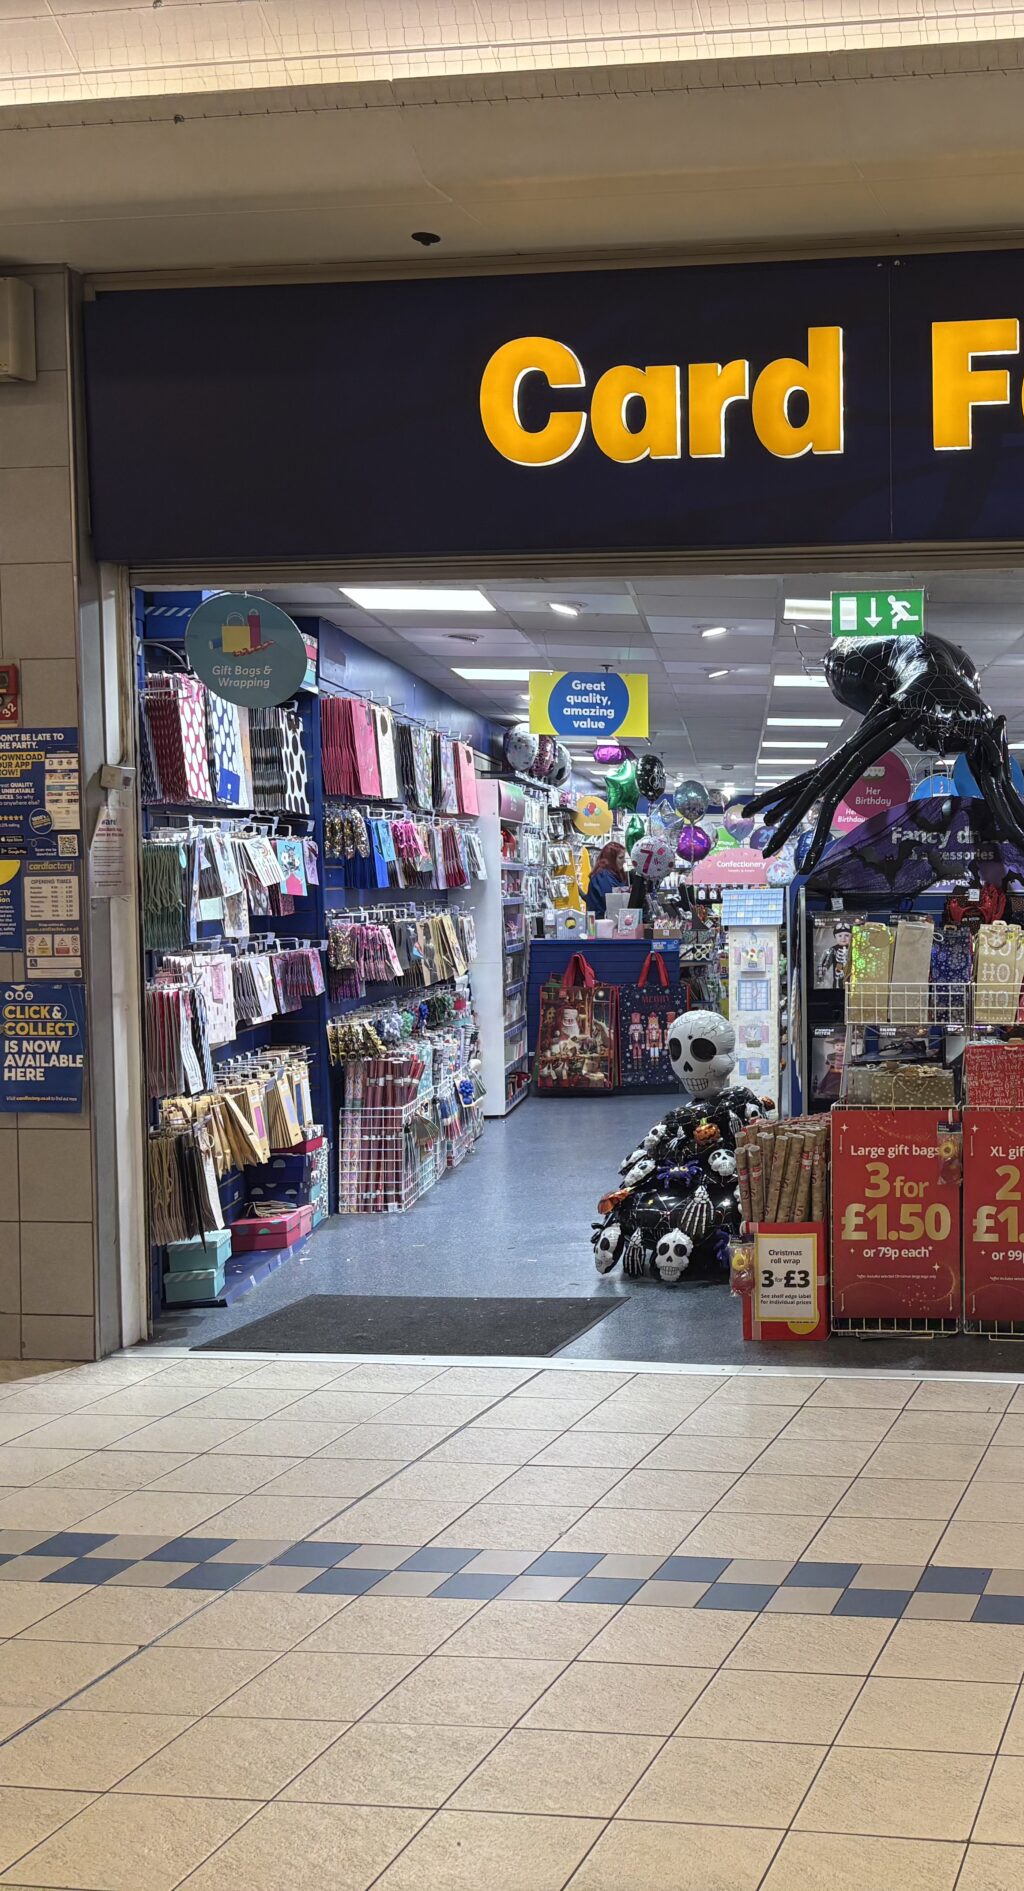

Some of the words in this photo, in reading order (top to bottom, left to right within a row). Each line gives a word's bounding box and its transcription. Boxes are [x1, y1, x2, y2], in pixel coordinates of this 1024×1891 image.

[480, 326, 844, 467] Card
[212, 665, 232, 675] Gift
[235, 665, 261, 677] Bags
[263, 665, 273, 675] &
[218, 677, 270, 689] Wrapping
[571, 680, 606, 691] Great
[566, 692, 611, 706] quality,
[563, 706, 615, 719] amazing
[572, 718, 606, 729] value
[21, 733, 31, 741] BE
[33, 733, 52, 741] LATE
[0, 768, 18, 776] OW!
[865, 787, 881, 795] Her
[855, 796, 891, 807] Birthday
[891, 827, 951, 848] Fancy
[29, 862, 72, 871] cardfactory
[716, 860, 766, 869] Confectionery
[982, 963, 1011, 982] HO
[4, 1006, 50, 1019] CLICK
[52, 1005, 62, 1019] &
[5, 1022, 75, 1036] COLLECT
[5, 1040, 18, 1053] IS
[22, 1040, 61, 1053] NOW
[4, 1054, 84, 1068] AVAILABLE
[4, 1068, 45, 1081] HERE
[851, 1145, 885, 1159] Large
[888, 1145, 909, 1158] gift
[912, 1145, 940, 1159] bags
[990, 1146, 1006, 1157] XL
[865, 1162, 890, 1198] 3
[893, 1176, 929, 1198] for
[995, 1164, 1021, 1200] 2
[841, 1203, 951, 1241] £1.50
[863, 1248, 877, 1258] or
[878, 1247, 899, 1260] 79p
[991, 1251, 1005, 1261] or
[761, 1270, 774, 1288] 3
[784, 1270, 810, 1288] £3
